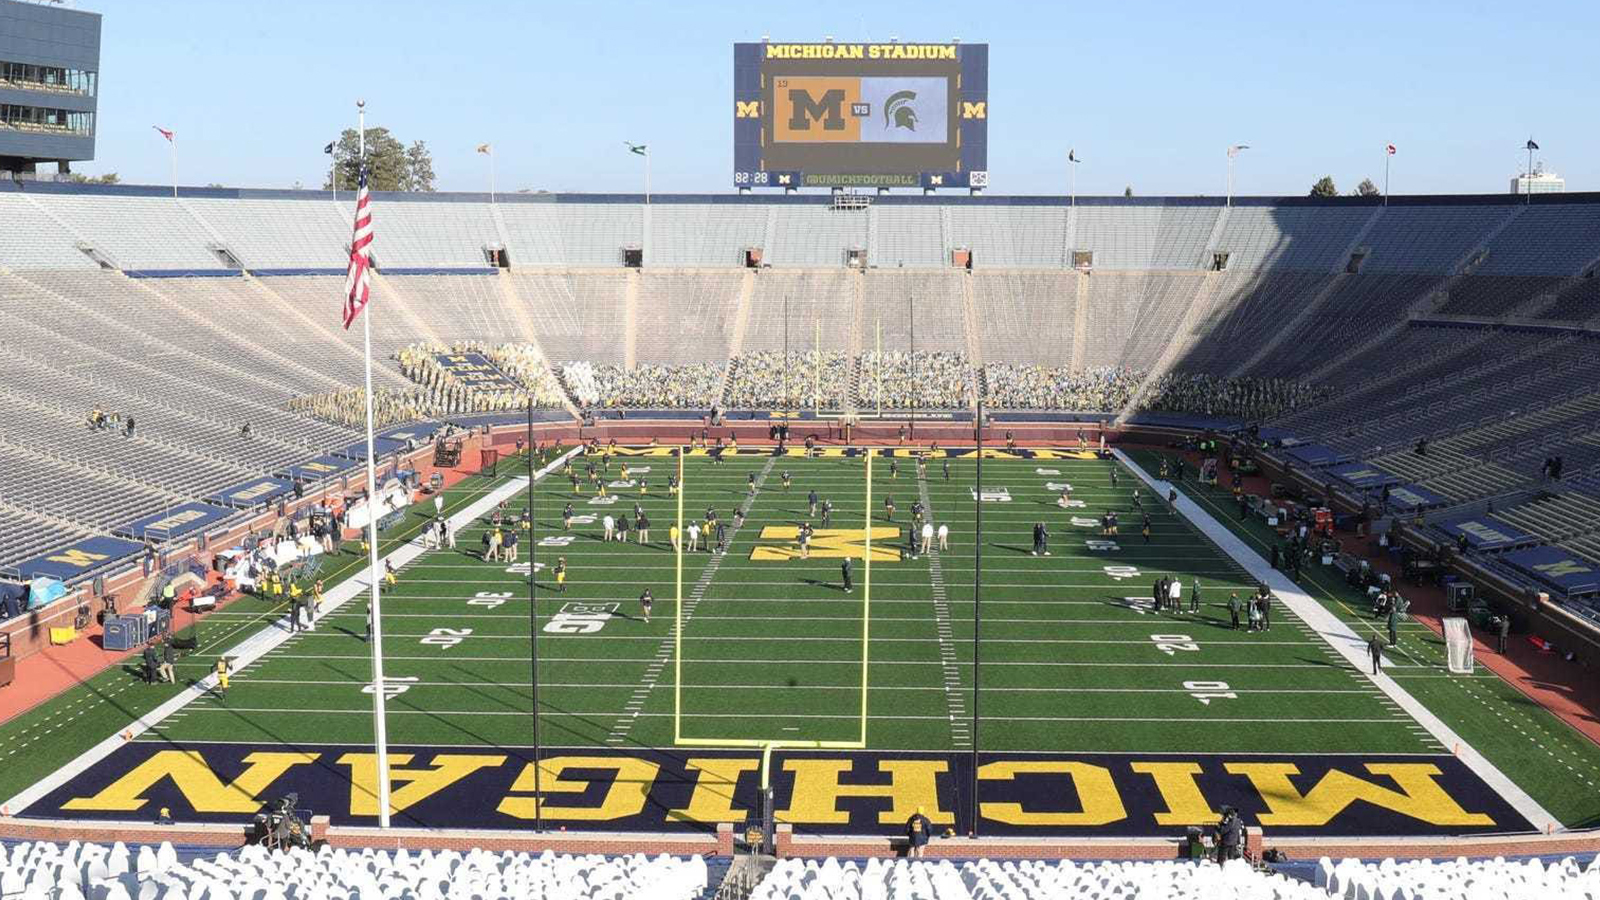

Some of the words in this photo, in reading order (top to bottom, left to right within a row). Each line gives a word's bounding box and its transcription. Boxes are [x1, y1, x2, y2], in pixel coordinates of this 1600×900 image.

[766, 44, 864, 59] MICHIGAN
[868, 45, 957, 59] STADIUM
[736, 101, 759, 118] M
[788, 89, 845, 130] M
[853, 105, 868, 115] VS
[963, 102, 986, 119] M
[735, 172, 768, 183] 82:28
[779, 174, 791, 183] M
[806, 173, 914, 184] @UMICHFOOTBALL
[931, 174, 942, 184] M
[419, 628, 473, 644] 20
[1150, 634, 1200, 651] 20
[1182, 681, 1238, 699] 10
[60, 750, 1496, 828] MICHIGAN
